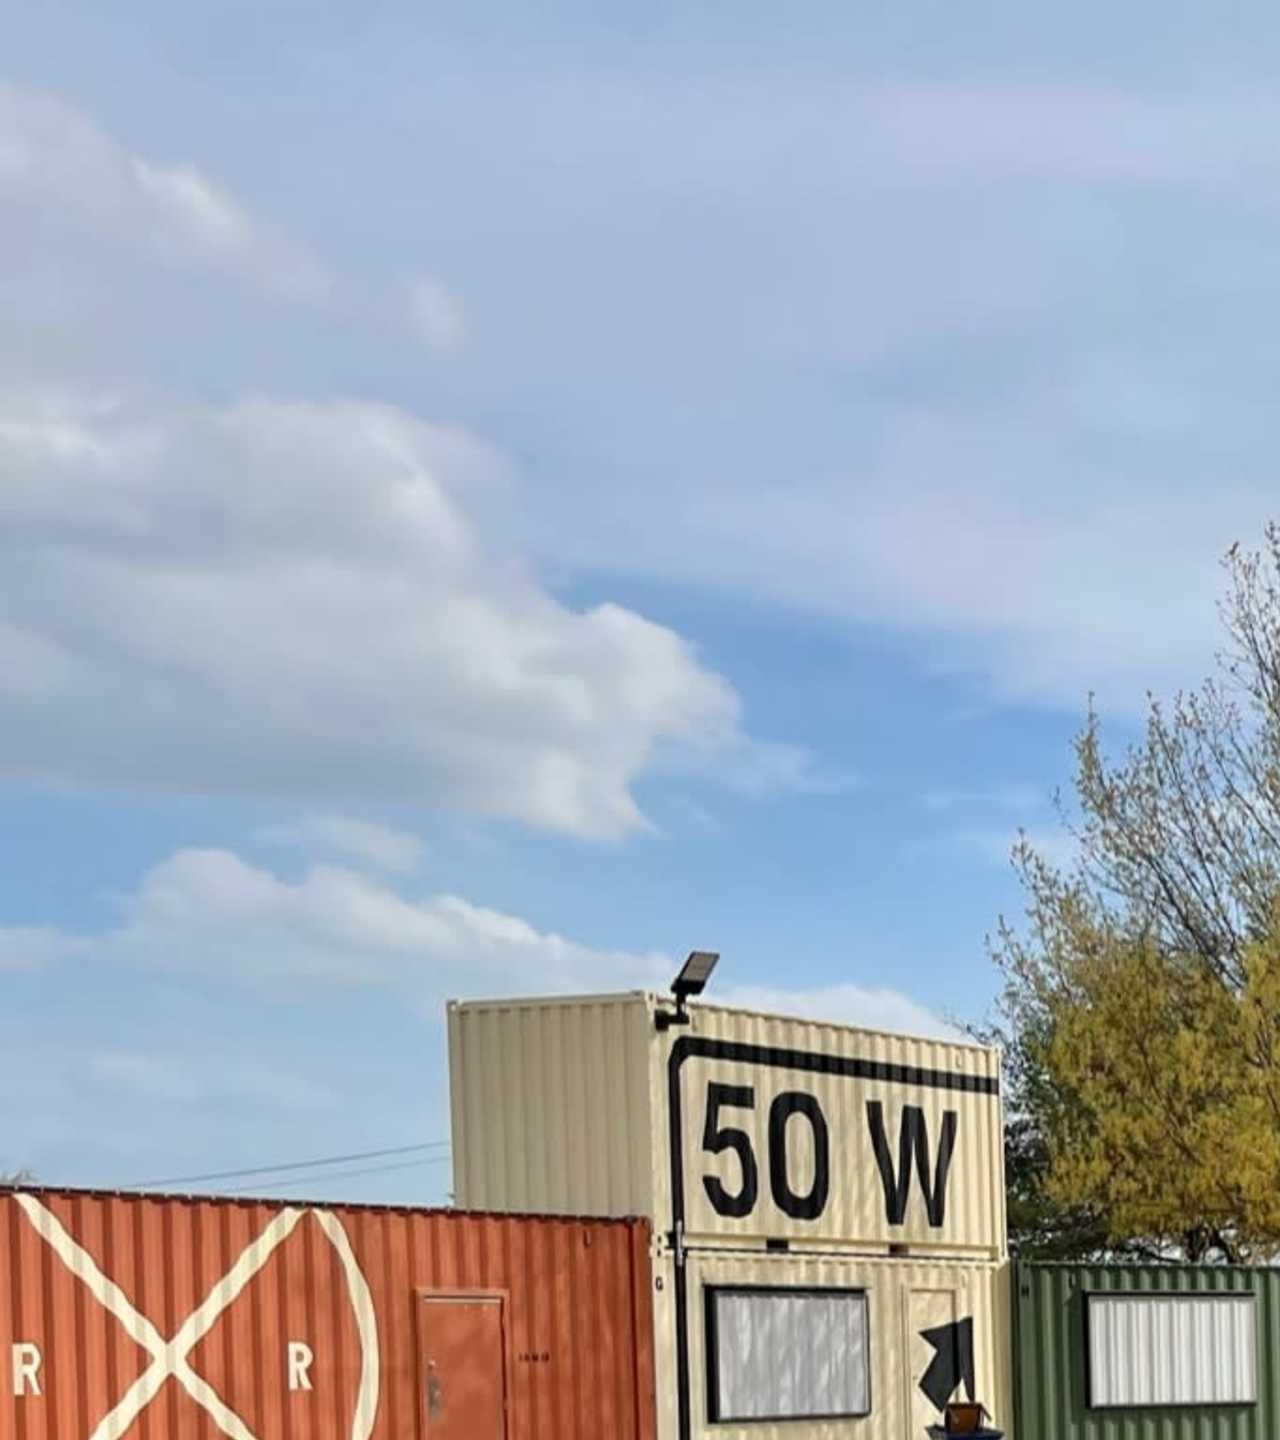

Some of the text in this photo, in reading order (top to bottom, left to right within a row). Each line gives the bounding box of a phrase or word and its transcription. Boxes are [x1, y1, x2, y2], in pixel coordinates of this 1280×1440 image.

[702, 1080, 957, 1228] 50 W
[11, 1341, 314, 1396] R R
